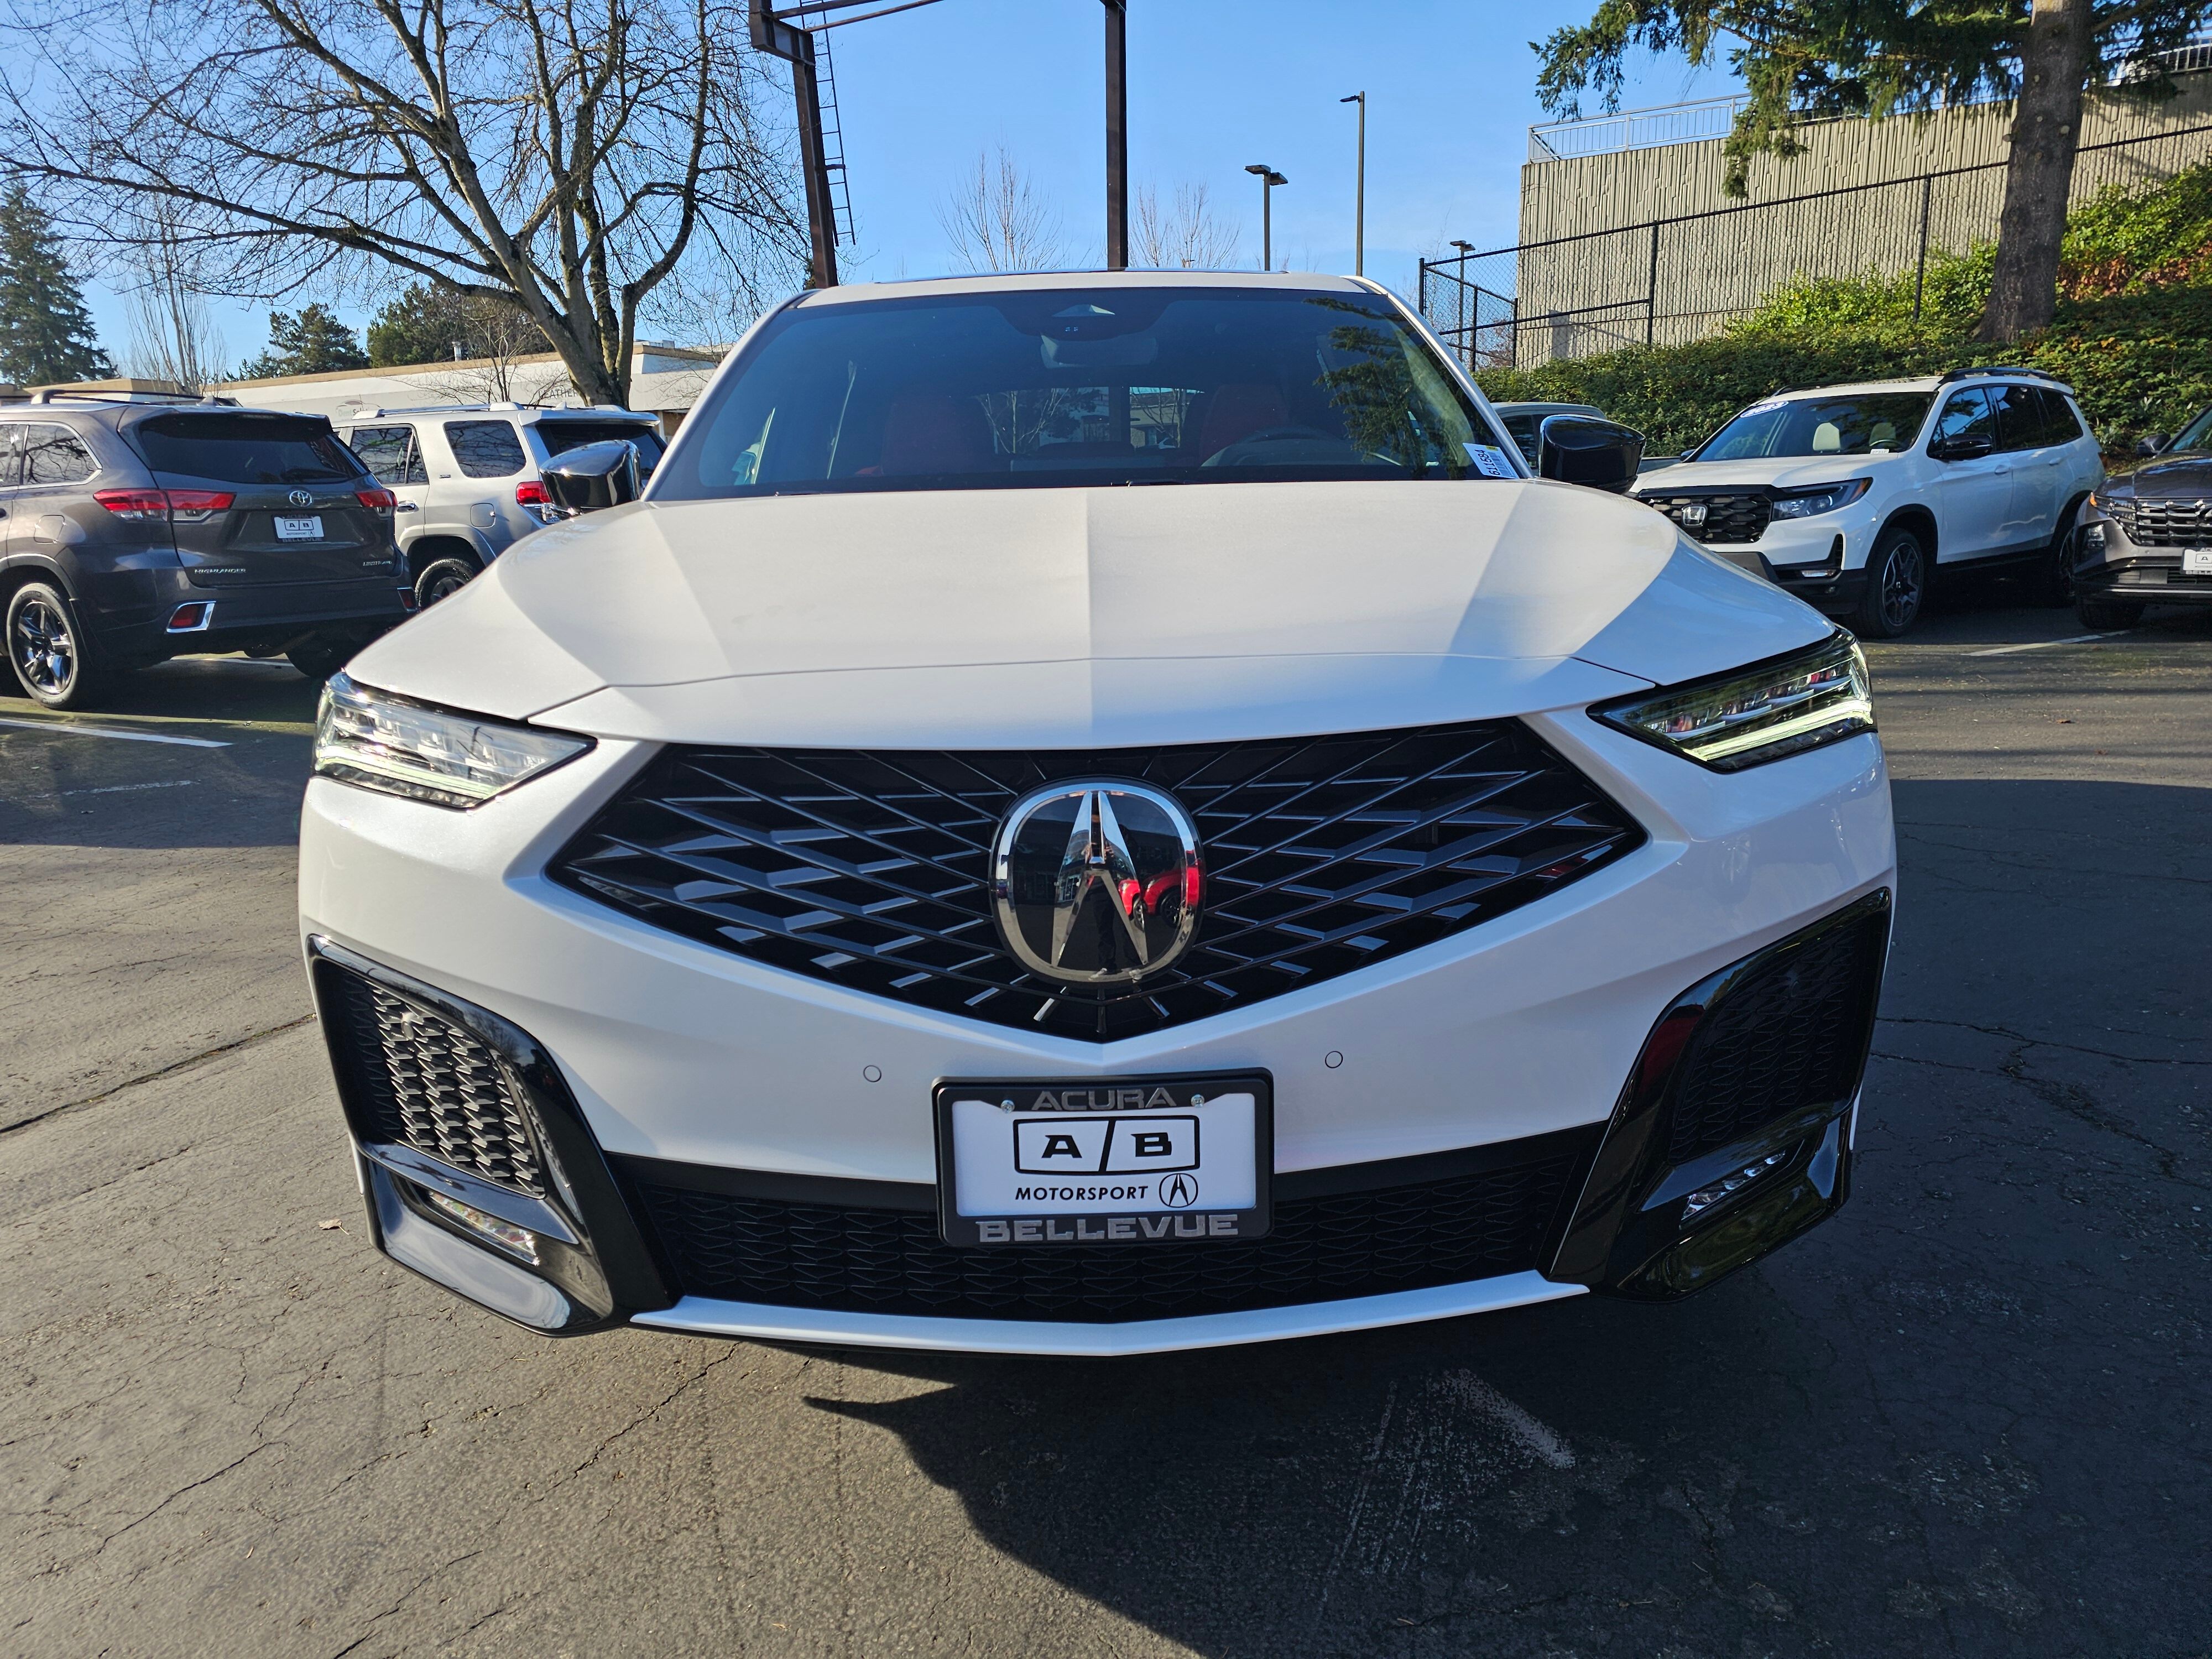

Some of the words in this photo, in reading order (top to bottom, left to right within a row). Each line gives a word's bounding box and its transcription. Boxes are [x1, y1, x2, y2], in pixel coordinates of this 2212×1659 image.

[1474, 449, 1500, 475] 611584
[1032, 1088, 1176, 1111] ACURA
[1015, 1186, 1148, 1200] MOTORSPORT
[975, 1214, 1238, 1243] BELLEVUE
